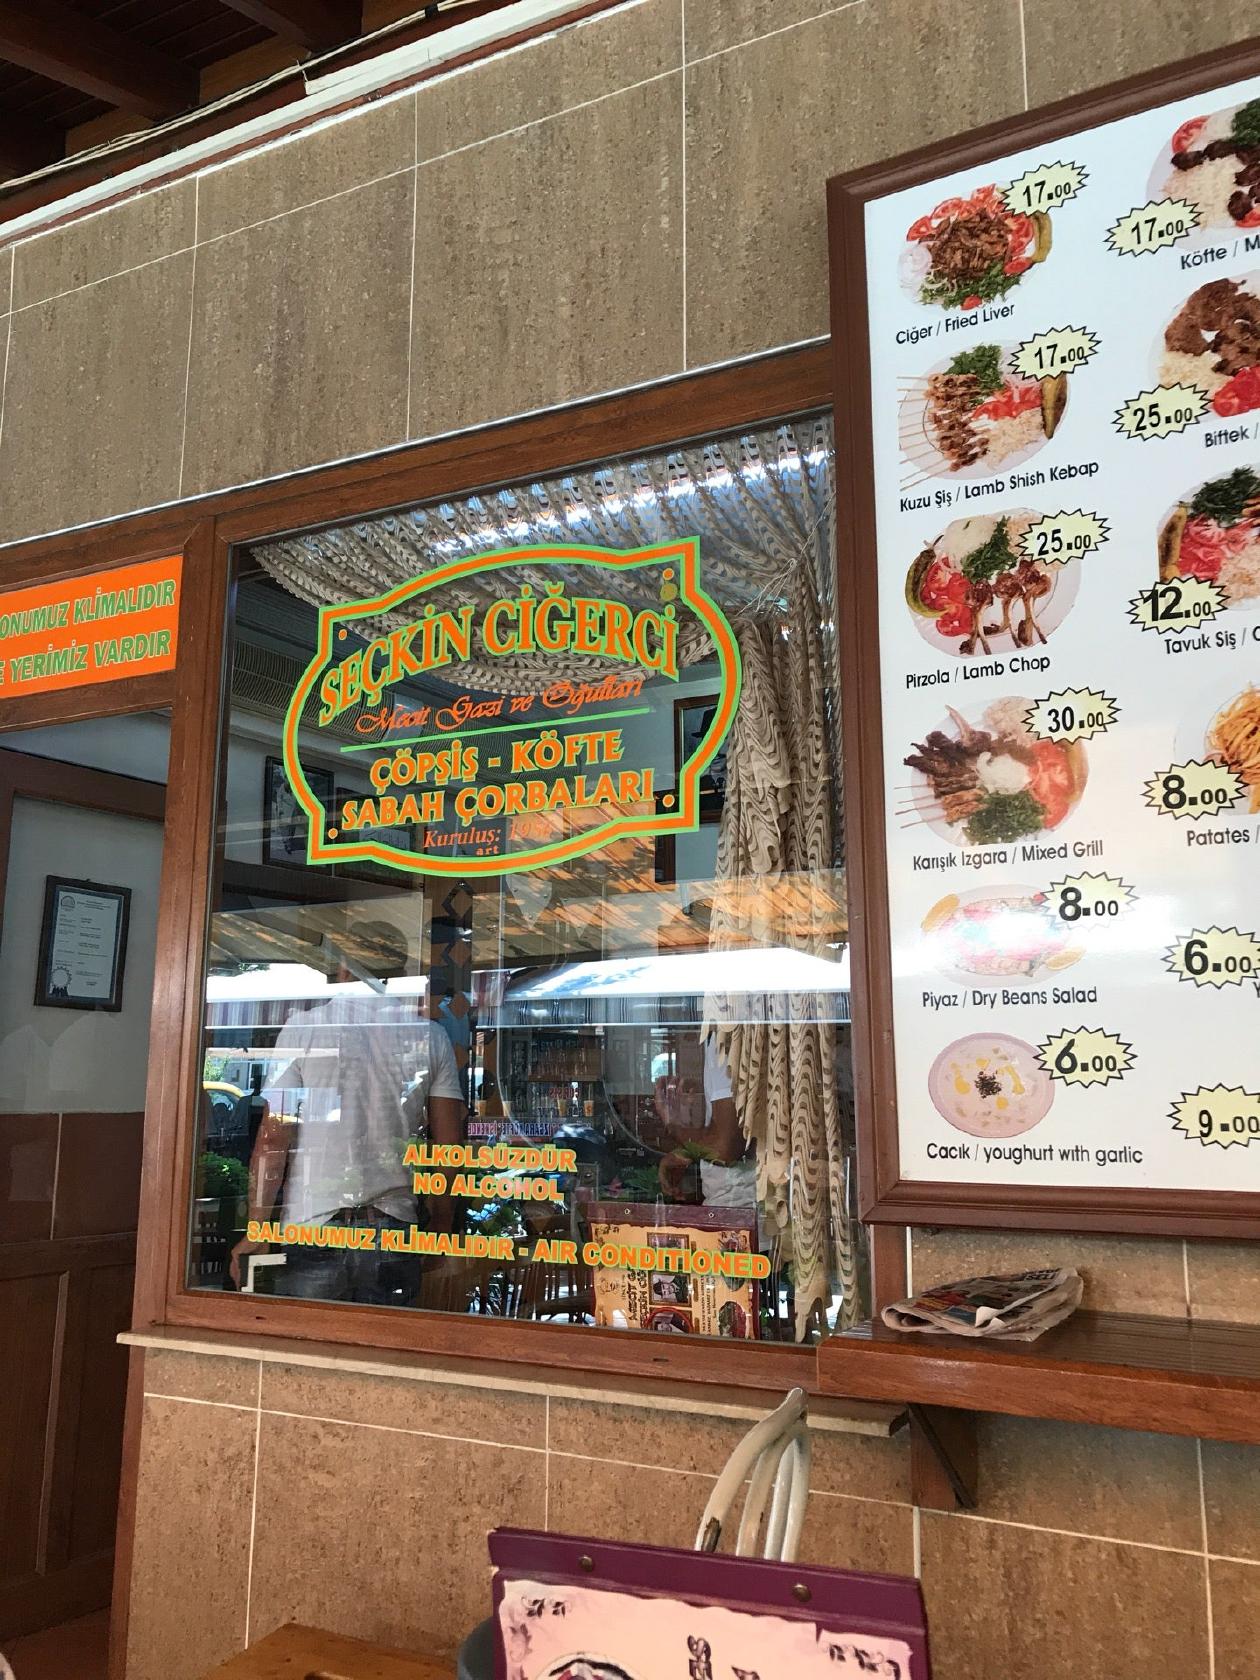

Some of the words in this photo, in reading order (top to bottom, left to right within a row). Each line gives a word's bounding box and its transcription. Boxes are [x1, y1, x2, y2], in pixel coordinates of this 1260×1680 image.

[1023, 180, 1072, 207] 17.00
[1131, 218, 1185, 245] 17.00
[1180, 247, 1227, 270] Köfte
[895, 325, 933, 344] Ciğer
[945, 311, 978, 332] Fried
[983, 304, 1015, 322] Liver
[1034, 343, 1085, 370] 17.00
[1133, 403, 1193, 432] 25.00
[1205, 425, 1250, 448] Biftek
[900, 495, 931, 512] Kuzu
[964, 479, 1005, 499] Lamb
[1009, 471, 1045, 490] Shish
[1050, 461, 1099, 482] Kebap
[1036, 528, 1092, 556] 25.00
[73, 579, 176, 625] KLİMALIDIR
[1143, 586, 1211, 621] 12.00
[10, 639, 90, 684] YERİMİZ
[94, 630, 171, 668] VARDIR
[319, 604, 475, 727] SEÇKİN
[483, 581, 679, 682] CİĞERCİ
[1164, 634, 1211, 654] Tavuk
[906, 669, 950, 689] Pirzola
[963, 661, 1004, 680] Lamb
[1009, 656, 1051, 673] Chop
[435, 695, 505, 730] Gazi
[509, 695, 535, 714] ve
[1047, 705, 1104, 733] 30.00
[370, 739, 478, 795] ÇÖPŞİŞ
[511, 729, 625, 774] KÖFTE
[340, 791, 445, 830] SABAH
[455, 768, 655, 827] ÇORBALARI
[1161, 774, 1228, 810] 8.00
[1186, 827, 1250, 847] Patates
[913, 852, 957, 872] Karışık
[961, 850, 1007, 869] Izgara
[1021, 843, 1068, 862] Mixed
[1073, 839, 1104, 857] Grill
[1058, 887, 1120, 921] 8.00
[1184, 939, 1251, 975] 6.00
[922, 992, 958, 1011] Piyaz
[972, 990, 997, 1009] Dry
[1002, 989, 1048, 1005] Beans
[1052, 986, 1097, 1004] Salad
[1054, 1039, 1117, 1074] 6.00
[1199, 1109, 1260, 1138] 9.00
[402, 1143, 578, 1172] ALKOLSÜZDÜR
[927, 1143, 970, 1159] Cacık
[983, 1144, 1054, 1165] youghurt
[1095, 1146, 1143, 1166] garlic
[413, 1172, 447, 1195] NO
[450, 1174, 565, 1201] ALCOHOL
[247, 1221, 376, 1250] SALONUMUZ
[380, 1225, 516, 1260] KLİMALIDIR
[532, 1238, 578, 1265] AIR
[583, 1242, 771, 1279] CONDITIONED
